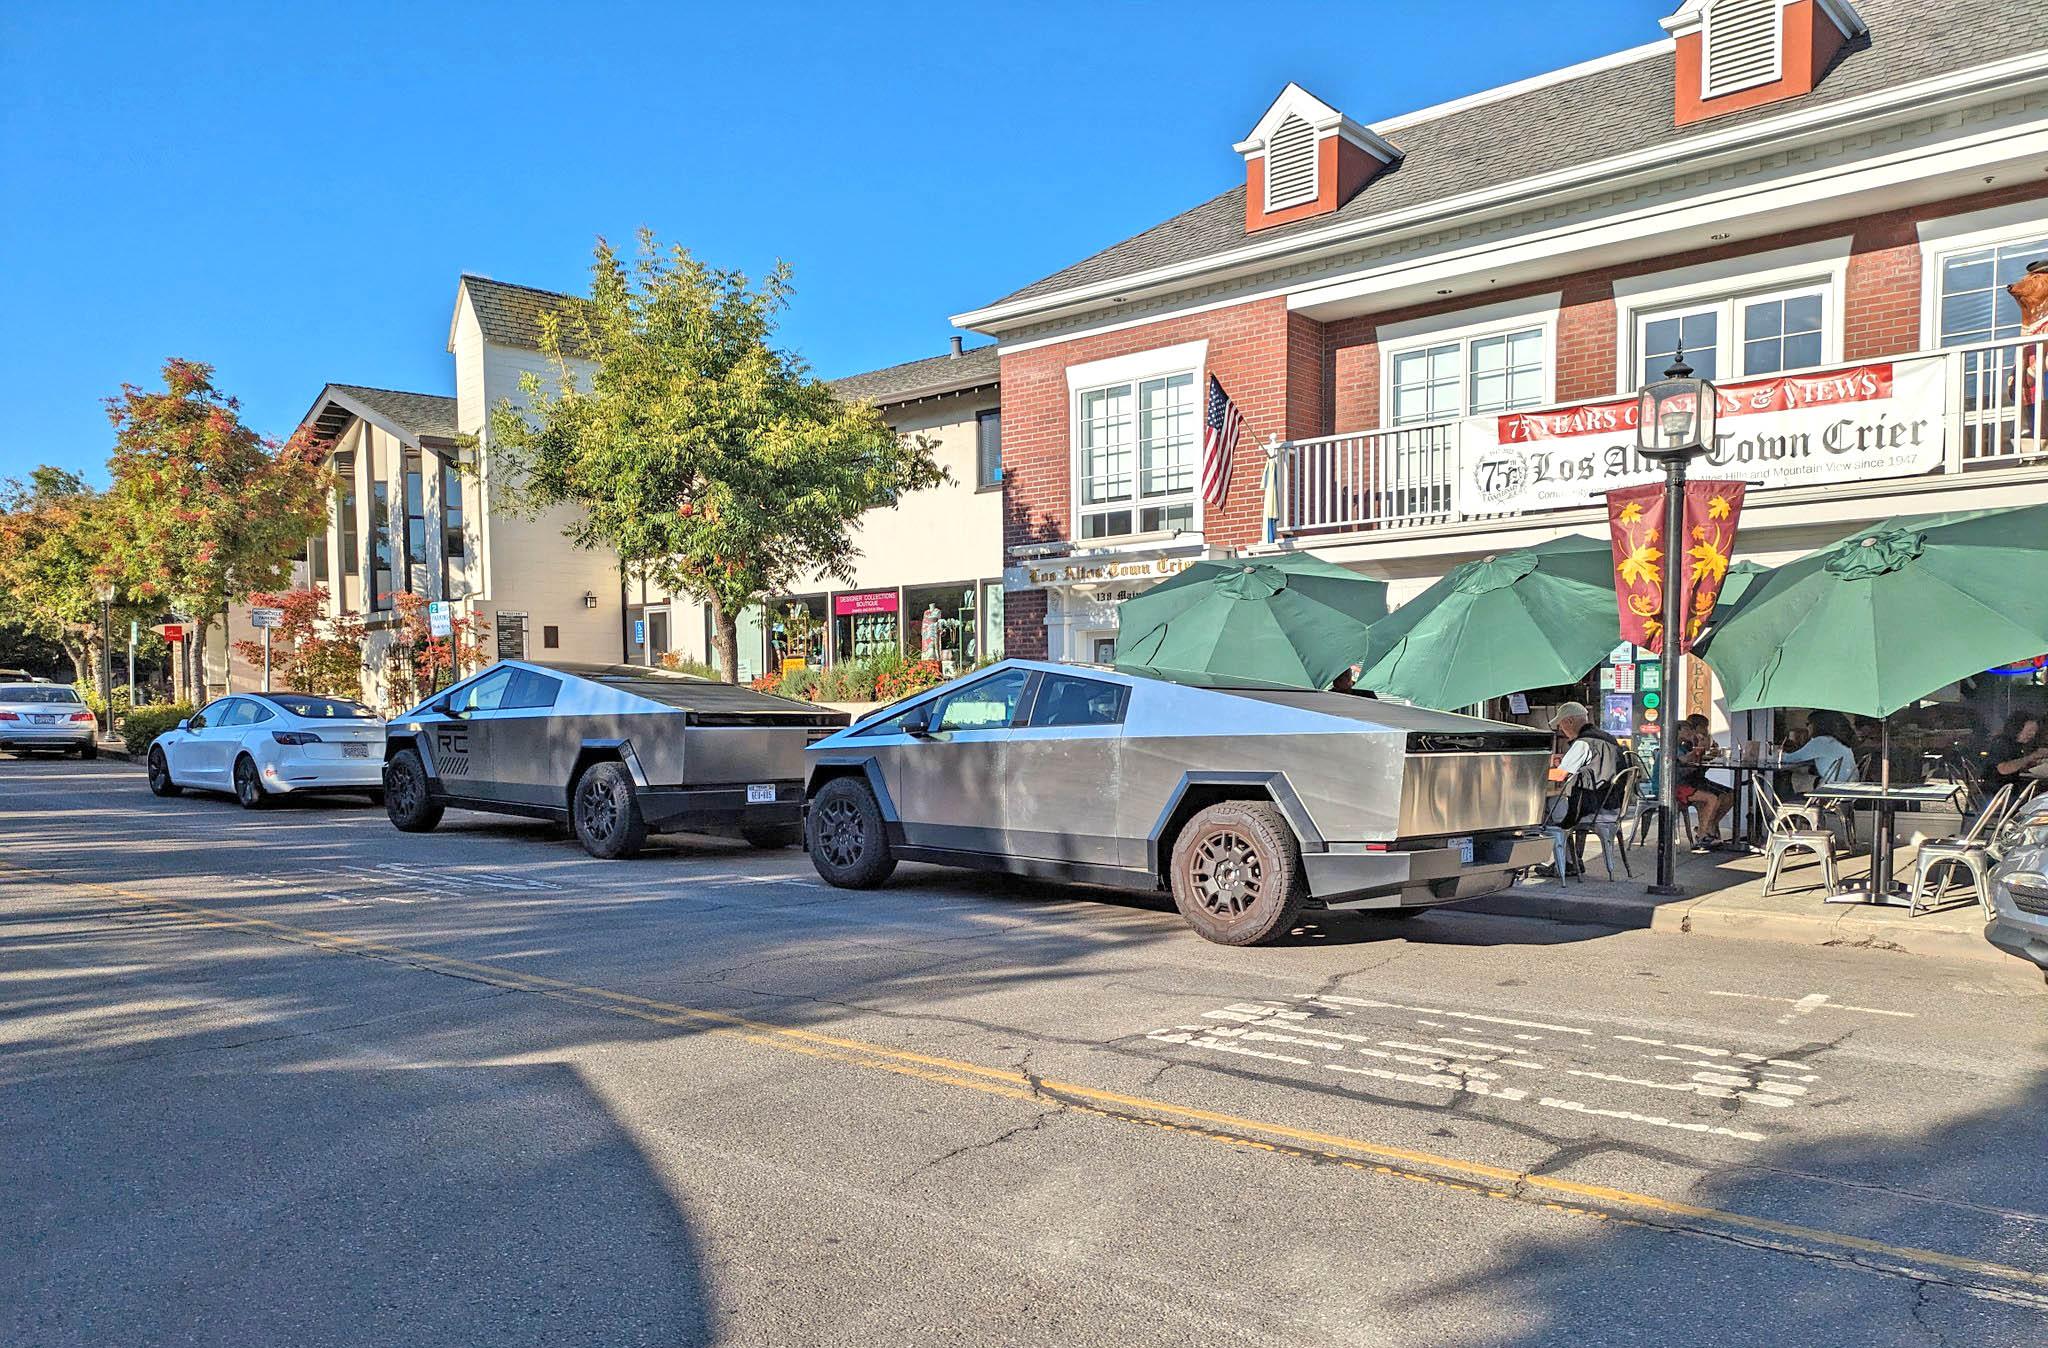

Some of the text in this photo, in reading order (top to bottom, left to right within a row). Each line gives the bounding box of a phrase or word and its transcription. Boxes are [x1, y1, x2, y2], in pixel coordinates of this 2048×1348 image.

[1509, 419, 1531, 439] 75
[1532, 409, 1617, 436] YEARS
[1783, 373, 1879, 409] VIEWS
[1530, 451, 1596, 485] Los
[1705, 431, 1812, 467] Town
[1822, 413, 1929, 455] Crier
[1773, 463, 1823, 477] Mountain
[1825, 461, 1852, 473] View
[1853, 457, 1885, 469] since
[1028, 568, 1057, 585] Los
[1062, 564, 1103, 581] Altos
[1108, 559, 1151, 577] Town
[437, 734, 469, 754] RC
